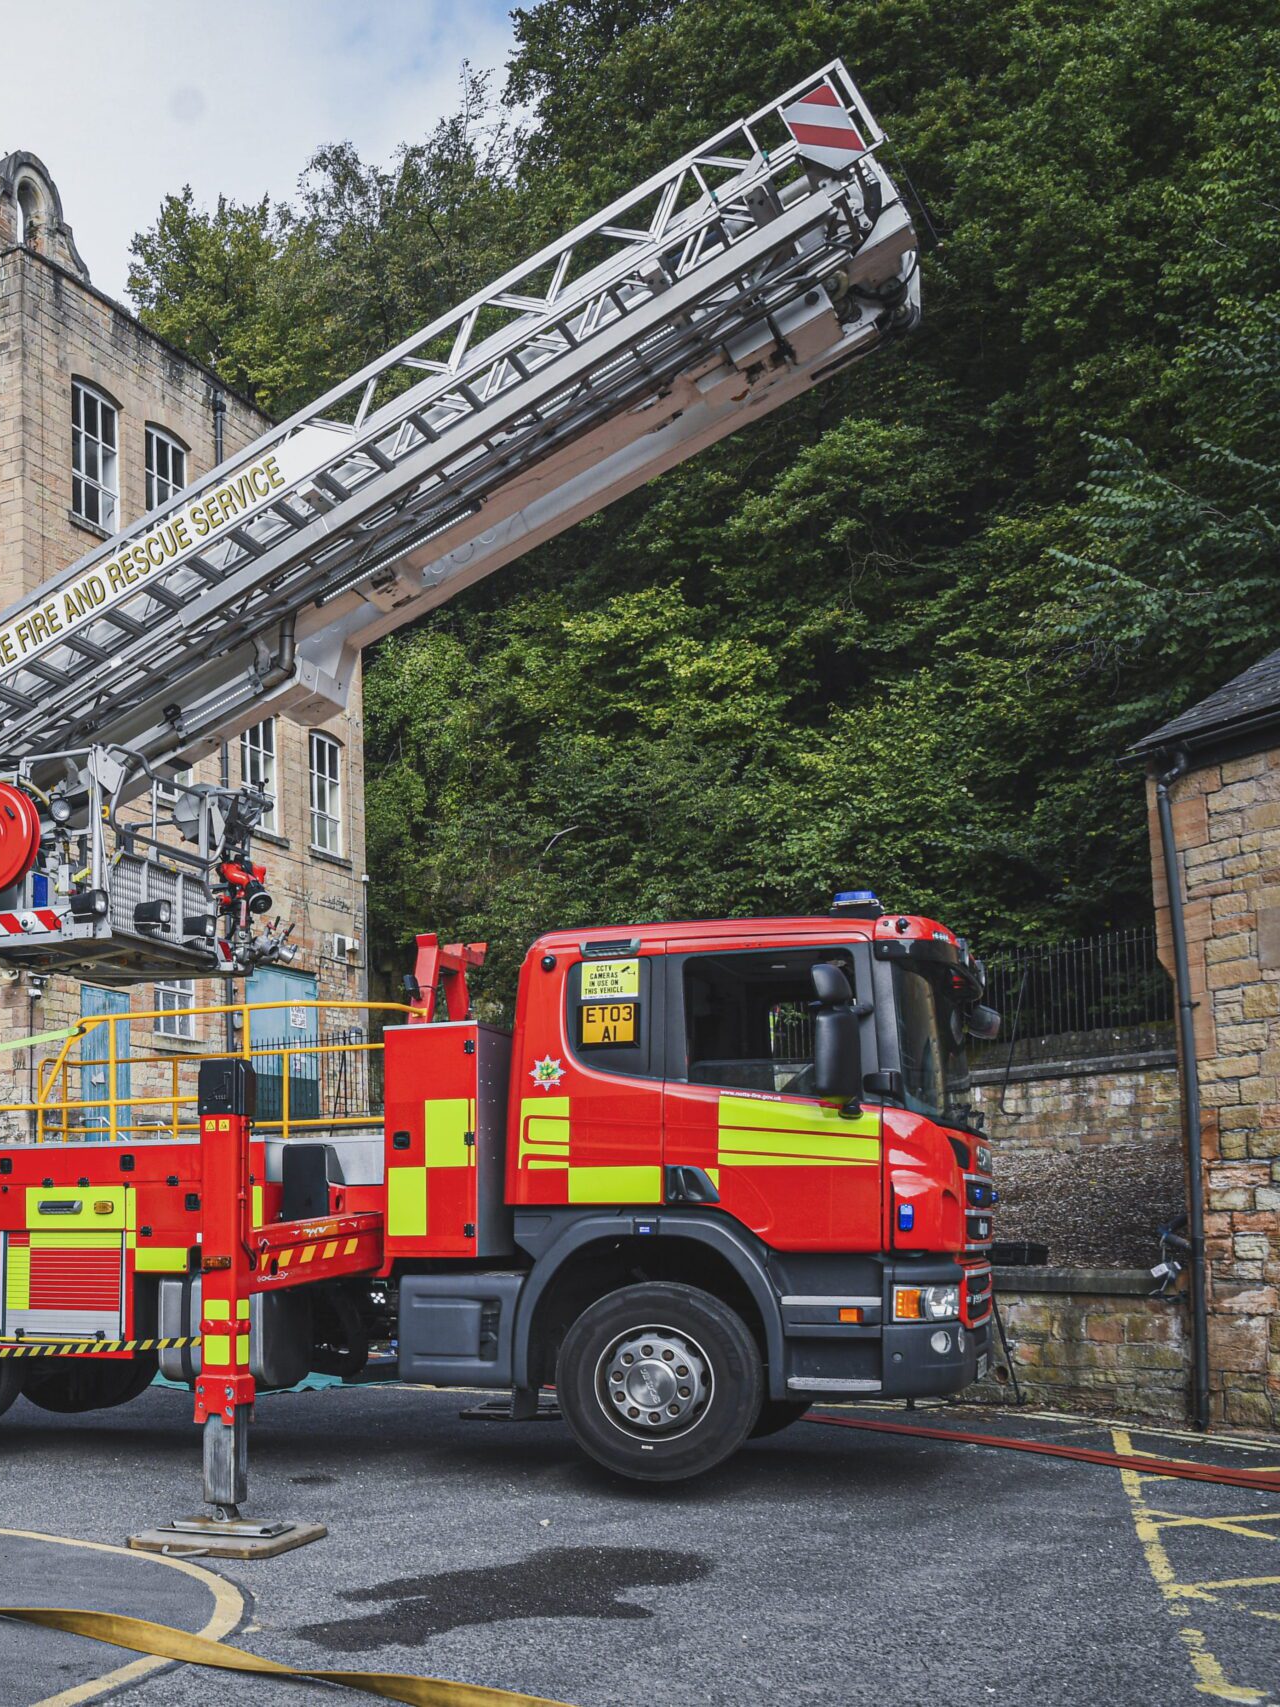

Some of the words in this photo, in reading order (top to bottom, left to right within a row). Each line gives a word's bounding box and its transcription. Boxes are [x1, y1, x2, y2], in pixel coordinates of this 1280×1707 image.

[14, 602, 63, 653] FIRE
[63, 575, 106, 623] AND
[105, 517, 193, 594] RESCUE
[189, 456, 286, 536] SERVICE
[586, 1005, 632, 1023] ET03
